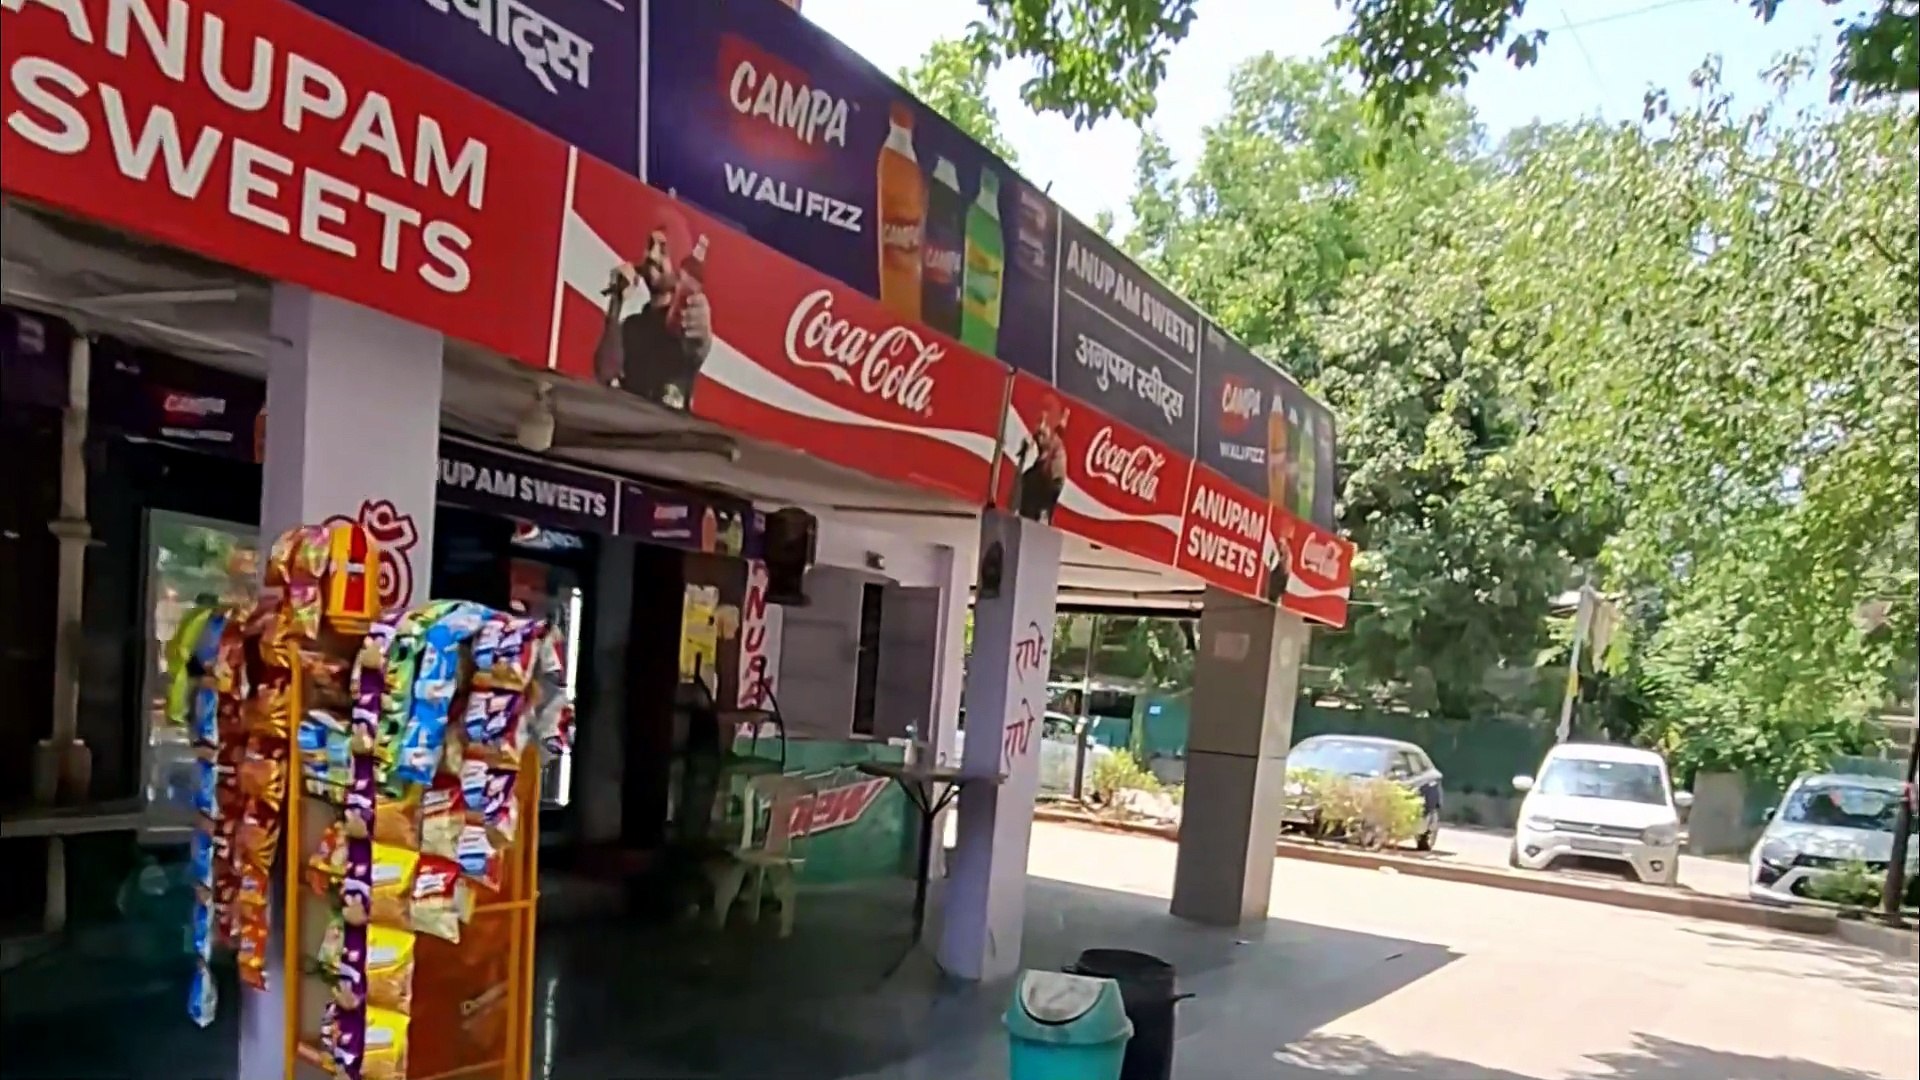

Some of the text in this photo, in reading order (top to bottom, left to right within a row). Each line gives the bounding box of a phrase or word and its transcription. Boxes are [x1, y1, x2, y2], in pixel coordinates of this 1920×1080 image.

[729, 60, 849, 148] CAMPA
[8, 55, 472, 293] SWEETS
[724, 162, 863, 233] WALI FIZZ
[1066, 240, 1141, 317] ANUPAM
[1141, 292, 1195, 354] SWEETS
[1075, 333, 1184, 426] अनुपम स्वीट्स
[519, 479, 607, 518] SWEETS
[1191, 485, 1265, 543] ANUPAM
[1187, 525, 1258, 579] SWEETS
